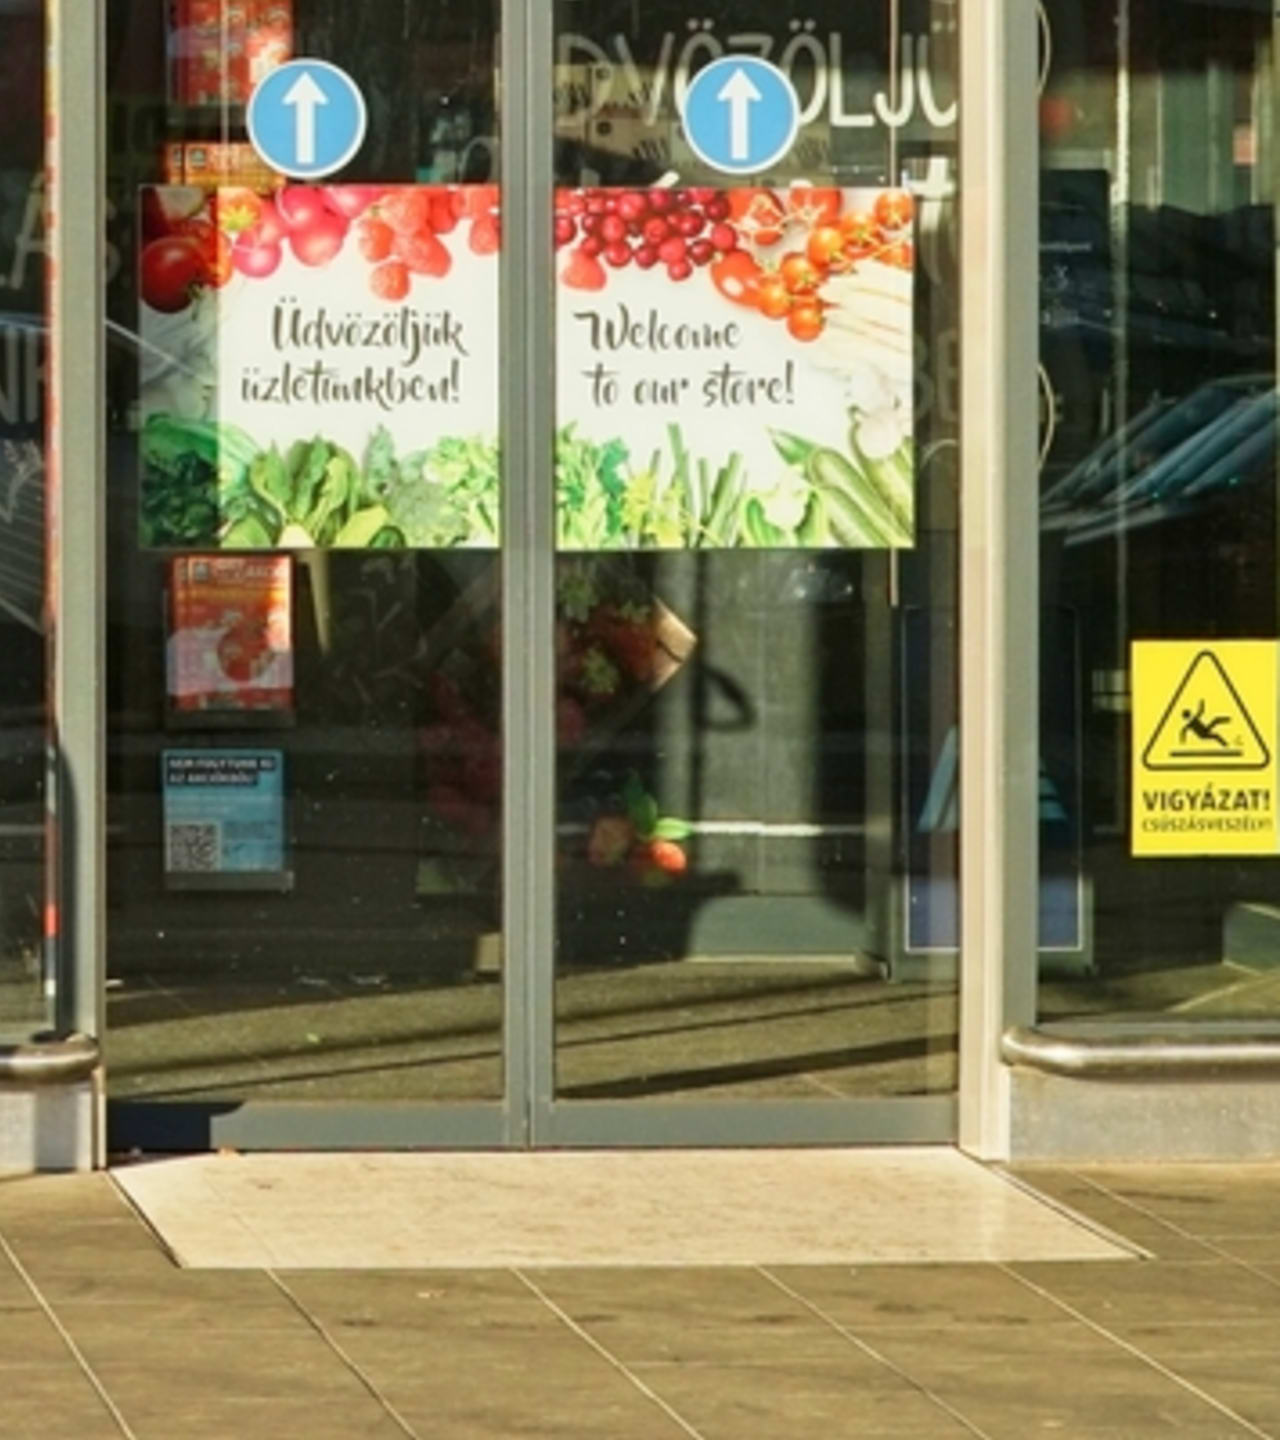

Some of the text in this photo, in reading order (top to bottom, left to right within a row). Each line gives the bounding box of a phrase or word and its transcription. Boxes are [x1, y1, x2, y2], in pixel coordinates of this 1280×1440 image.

[272, 296, 470, 368] Üdvözöljük
[572, 301, 740, 352] Welcome
[241, 357, 460, 411] üzletünkben!
[580, 359, 795, 408] to our store!
[1142, 781, 1271, 812] VIGYÁZAT!
